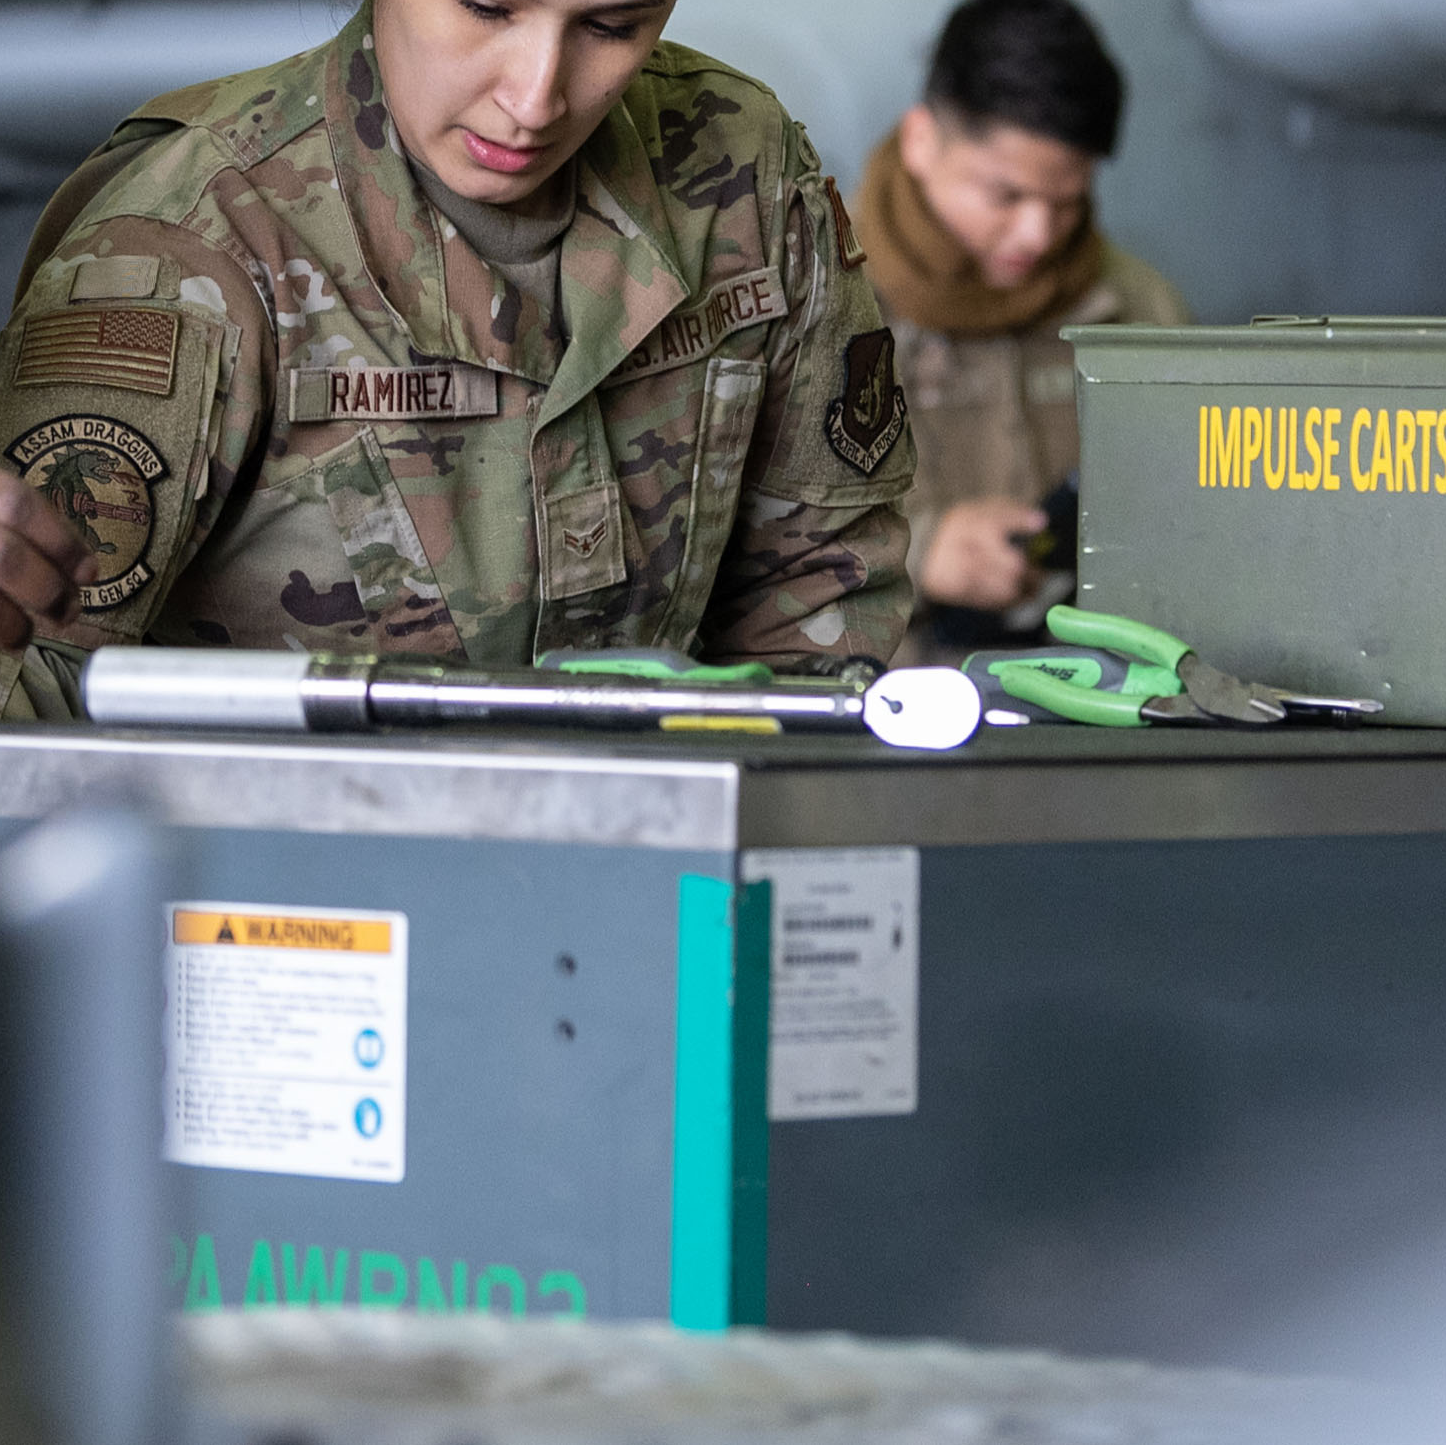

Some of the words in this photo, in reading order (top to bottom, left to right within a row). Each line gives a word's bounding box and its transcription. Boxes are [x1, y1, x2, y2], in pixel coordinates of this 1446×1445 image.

[660, 314, 705, 362] AIR
[706, 278, 773, 345] FORCE
[331, 371, 453, 413] RAMIREZ
[20, 421, 75, 460] ASSAM
[83, 421, 159, 475] DRAGGINS
[831, 425, 860, 462] PACIFIC
[859, 452, 878, 470] AIR
[875, 412, 902, 455] FORCES
[1199, 406, 1342, 491] IMPULSE
[98, 585, 124, 605] GEN
[129, 571, 143, 592] SQ
[247, 919, 354, 951] WARNING
